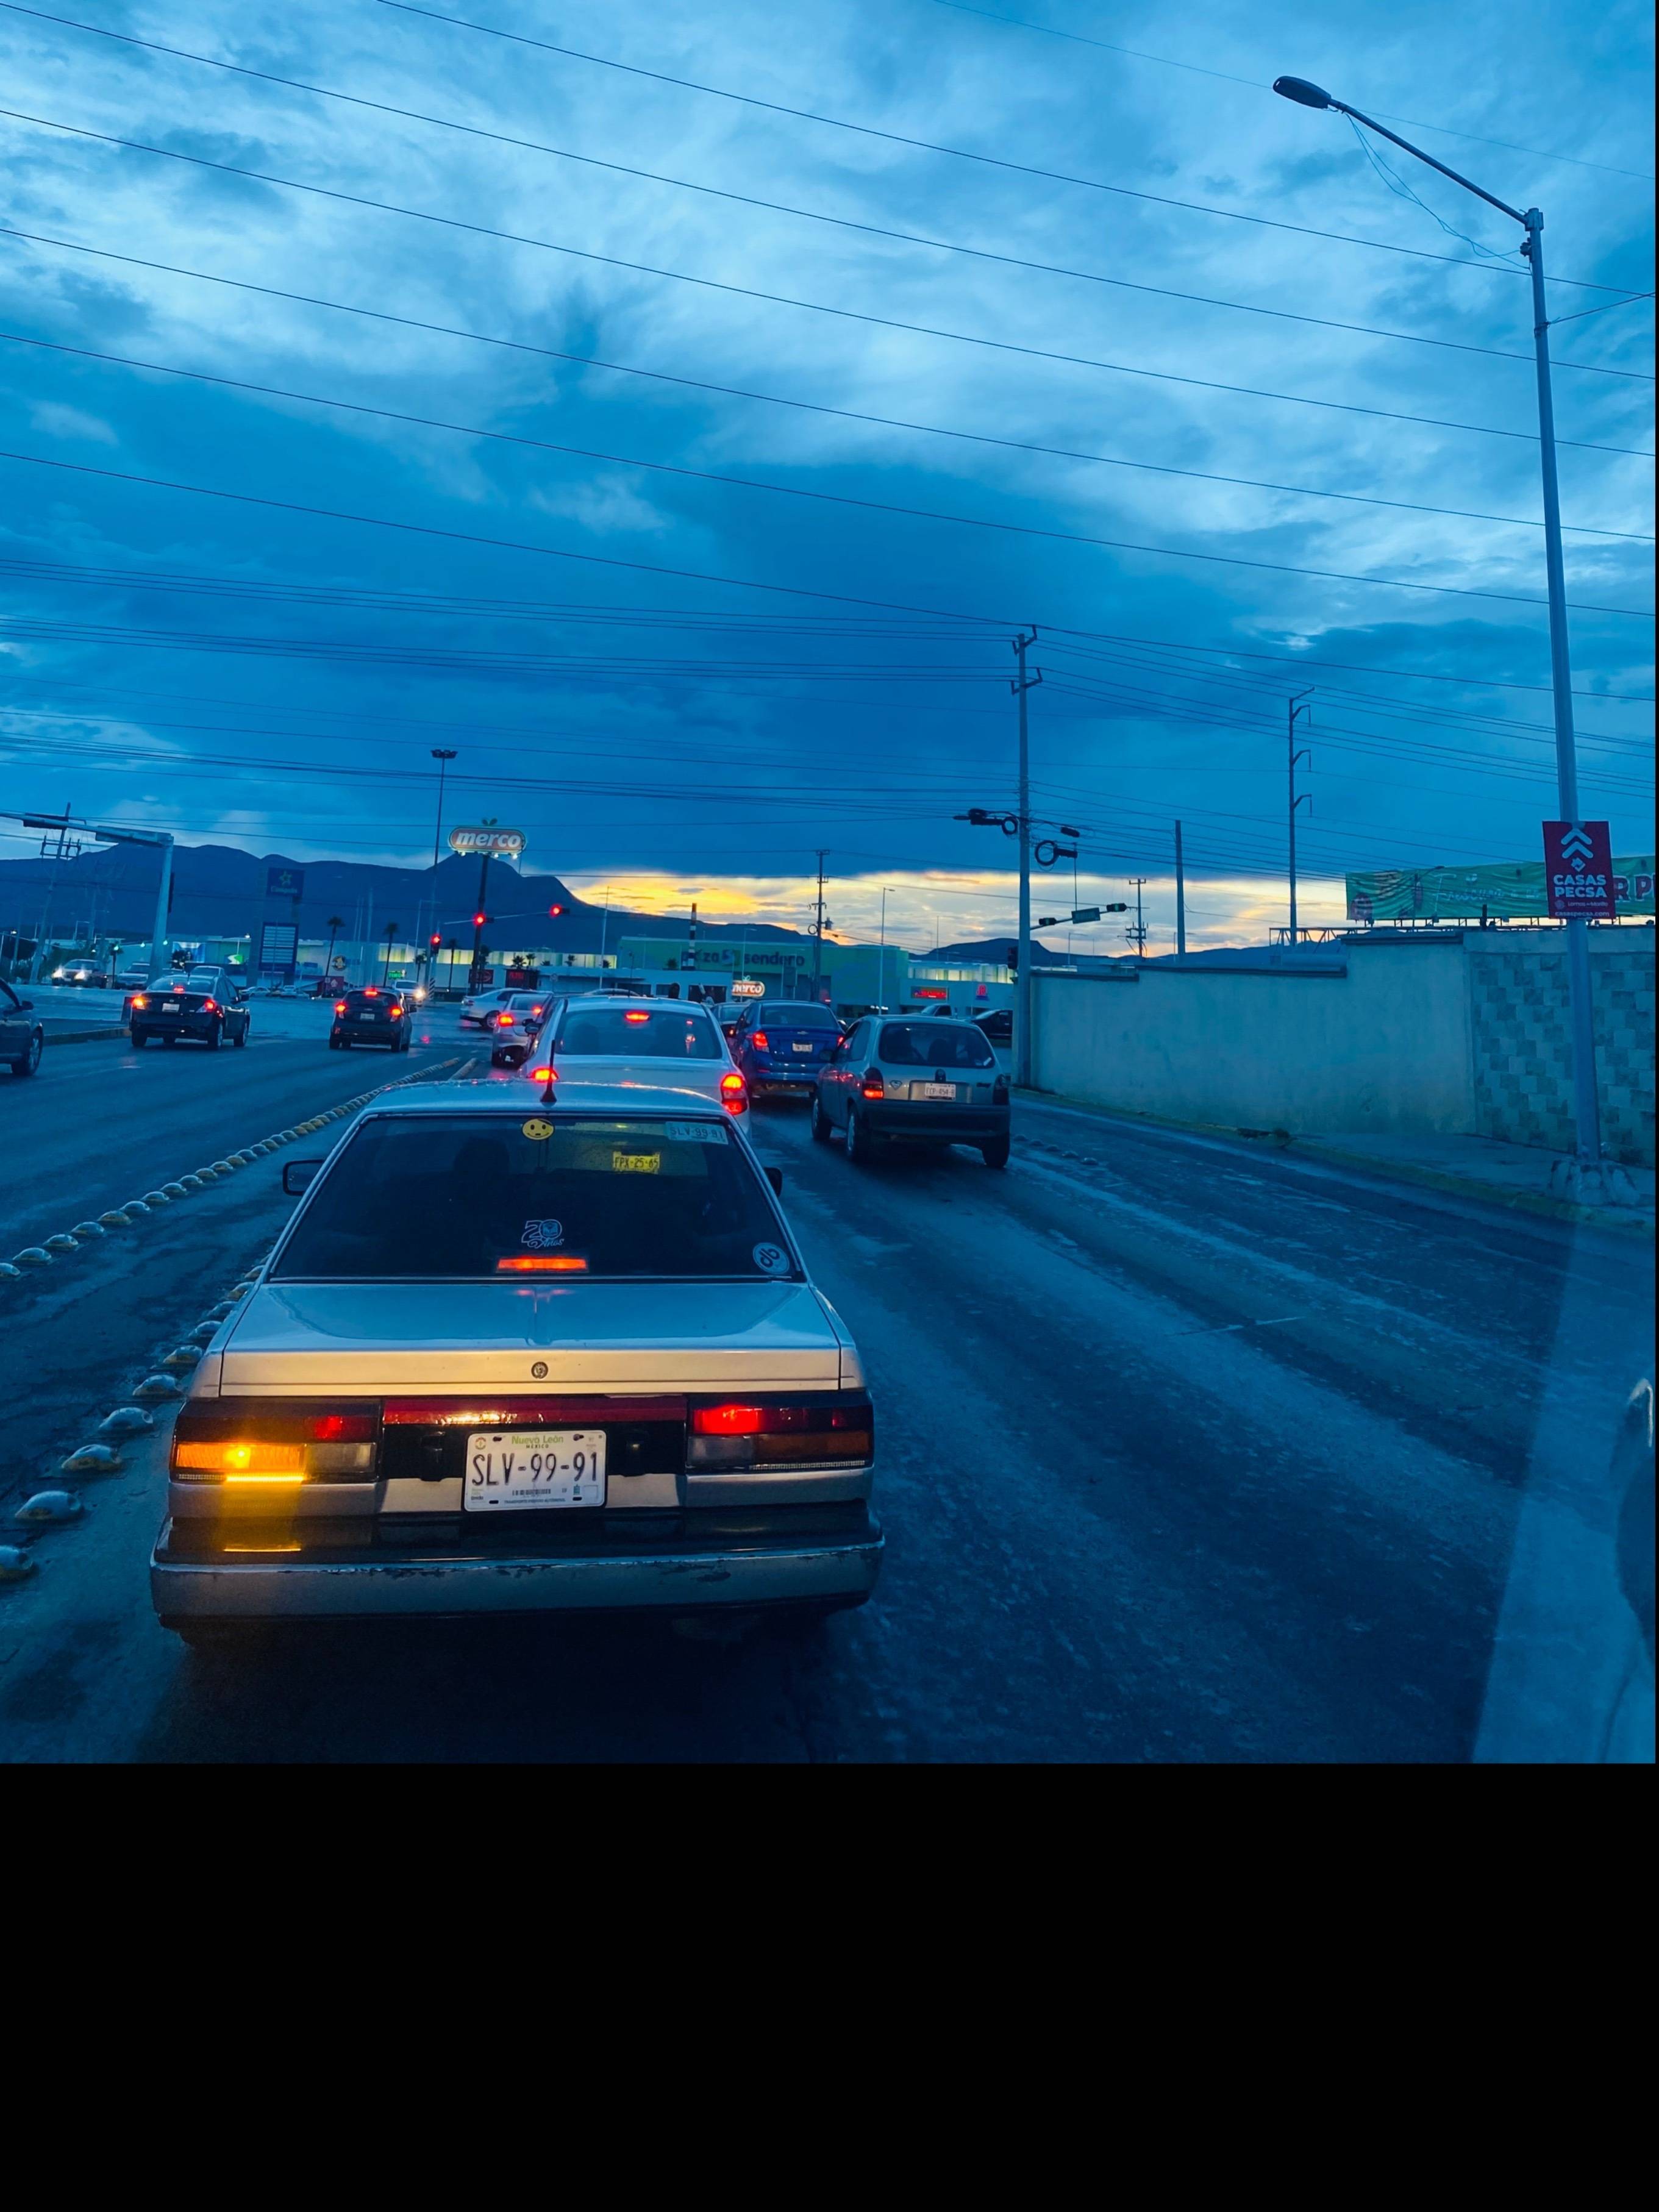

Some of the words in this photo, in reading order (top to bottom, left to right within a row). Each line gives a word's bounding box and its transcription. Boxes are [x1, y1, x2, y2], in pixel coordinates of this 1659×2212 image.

[455, 833, 521, 847] merco
[1553, 874, 1607, 885] CASAS
[1555, 887, 1608, 898] PECSA
[744, 951, 805, 966] sendero
[512, 1436, 540, 1444] Nuevo
[543, 1435, 564, 1444] León
[471, 1451, 598, 1486] SLV-99-91
